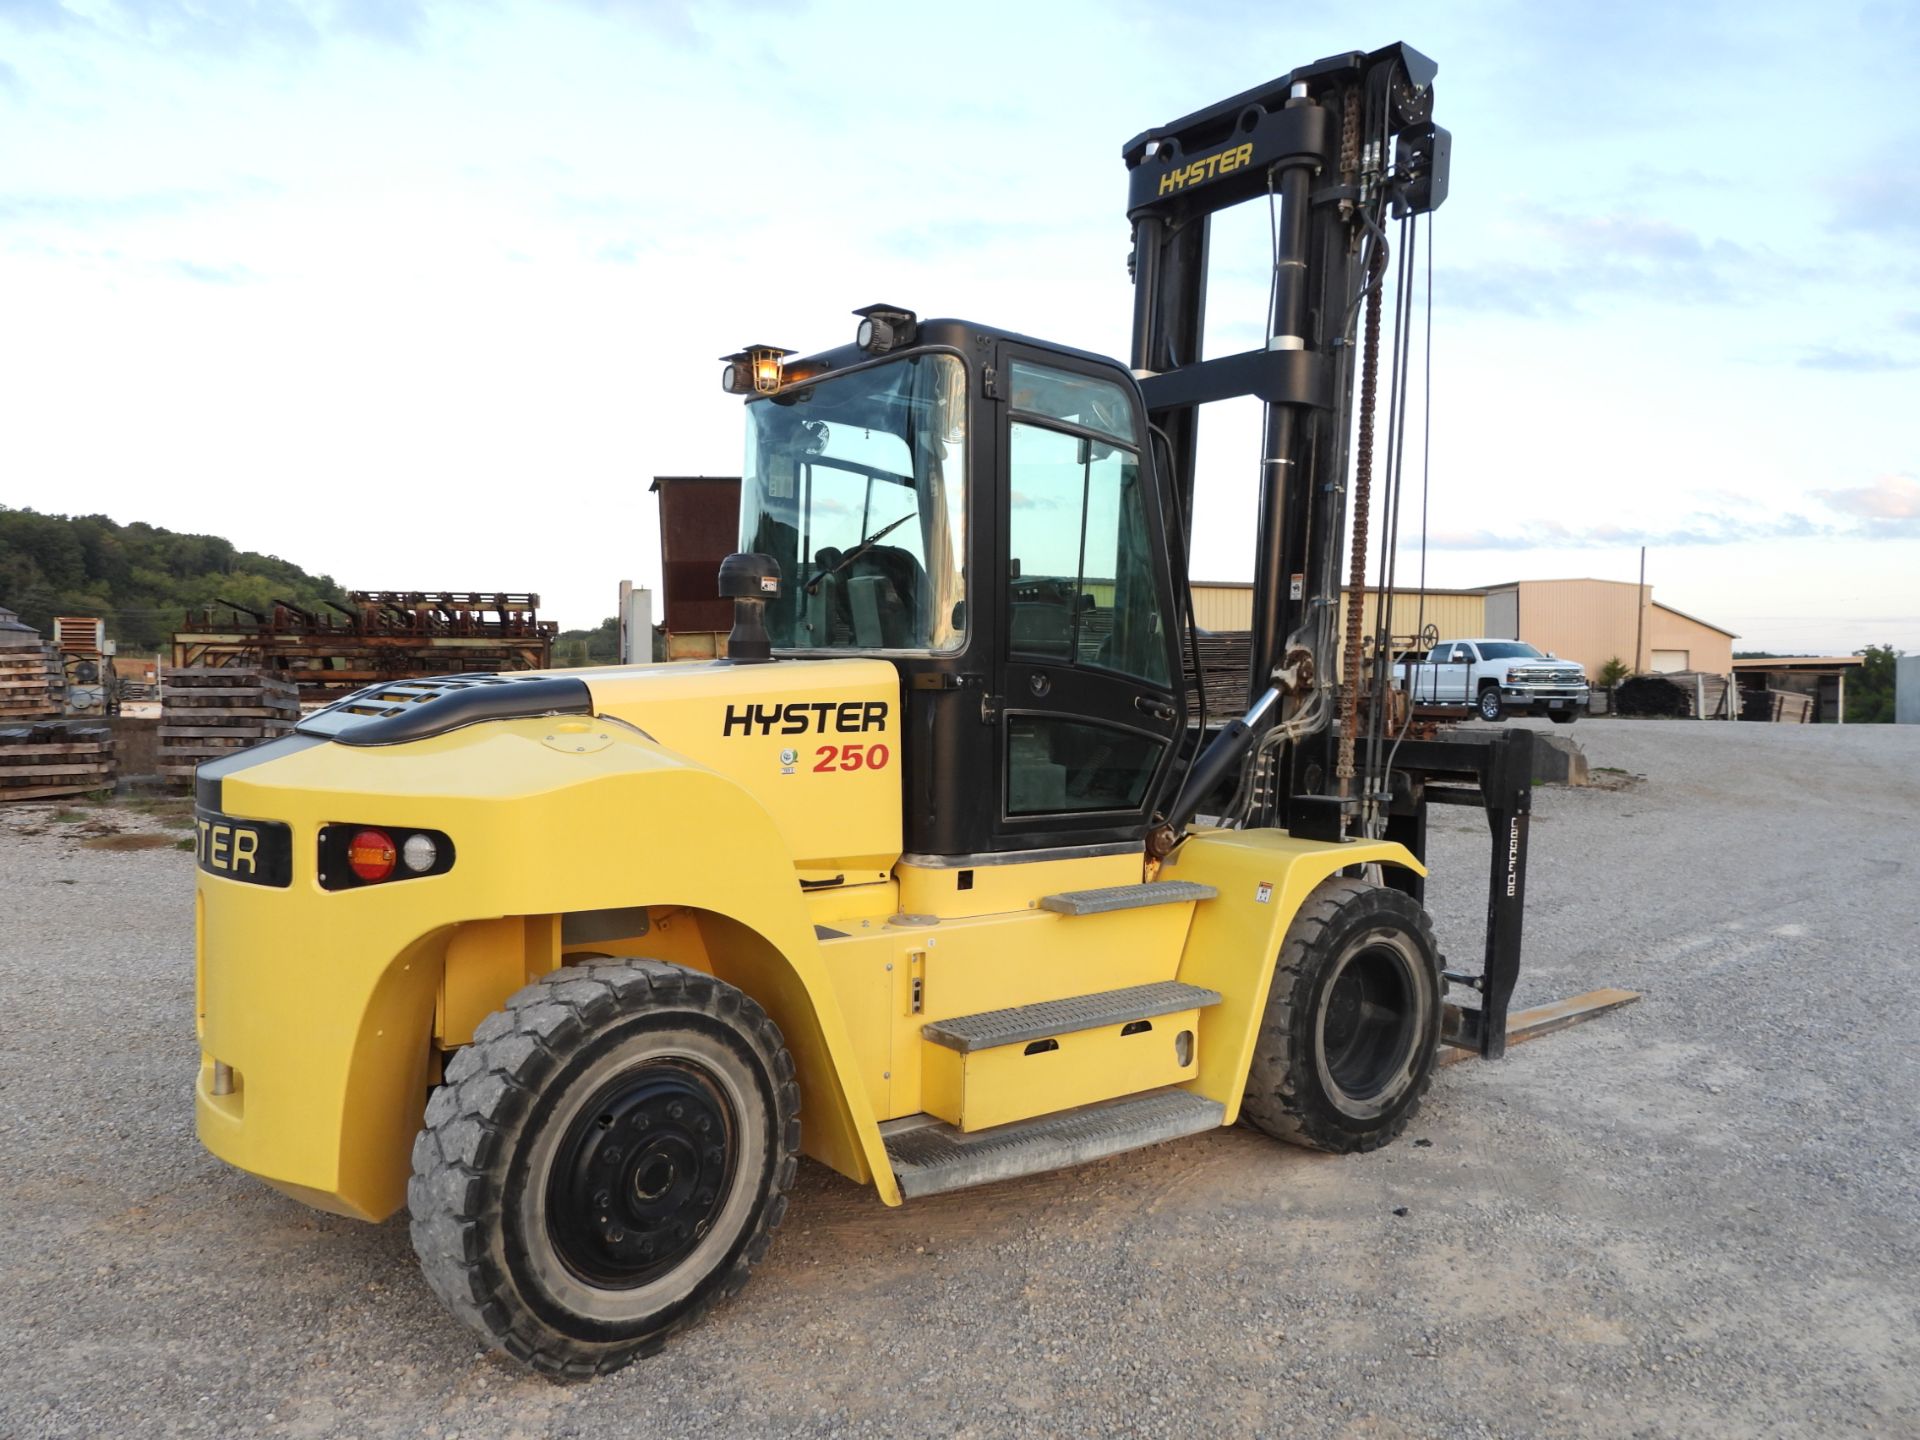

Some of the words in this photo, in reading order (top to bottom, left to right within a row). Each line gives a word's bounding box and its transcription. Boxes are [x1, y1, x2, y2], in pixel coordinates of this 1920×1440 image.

[1159, 143, 1253, 196] HYSTER
[723, 702, 888, 736] HYSTER
[813, 744, 889, 772] 250
